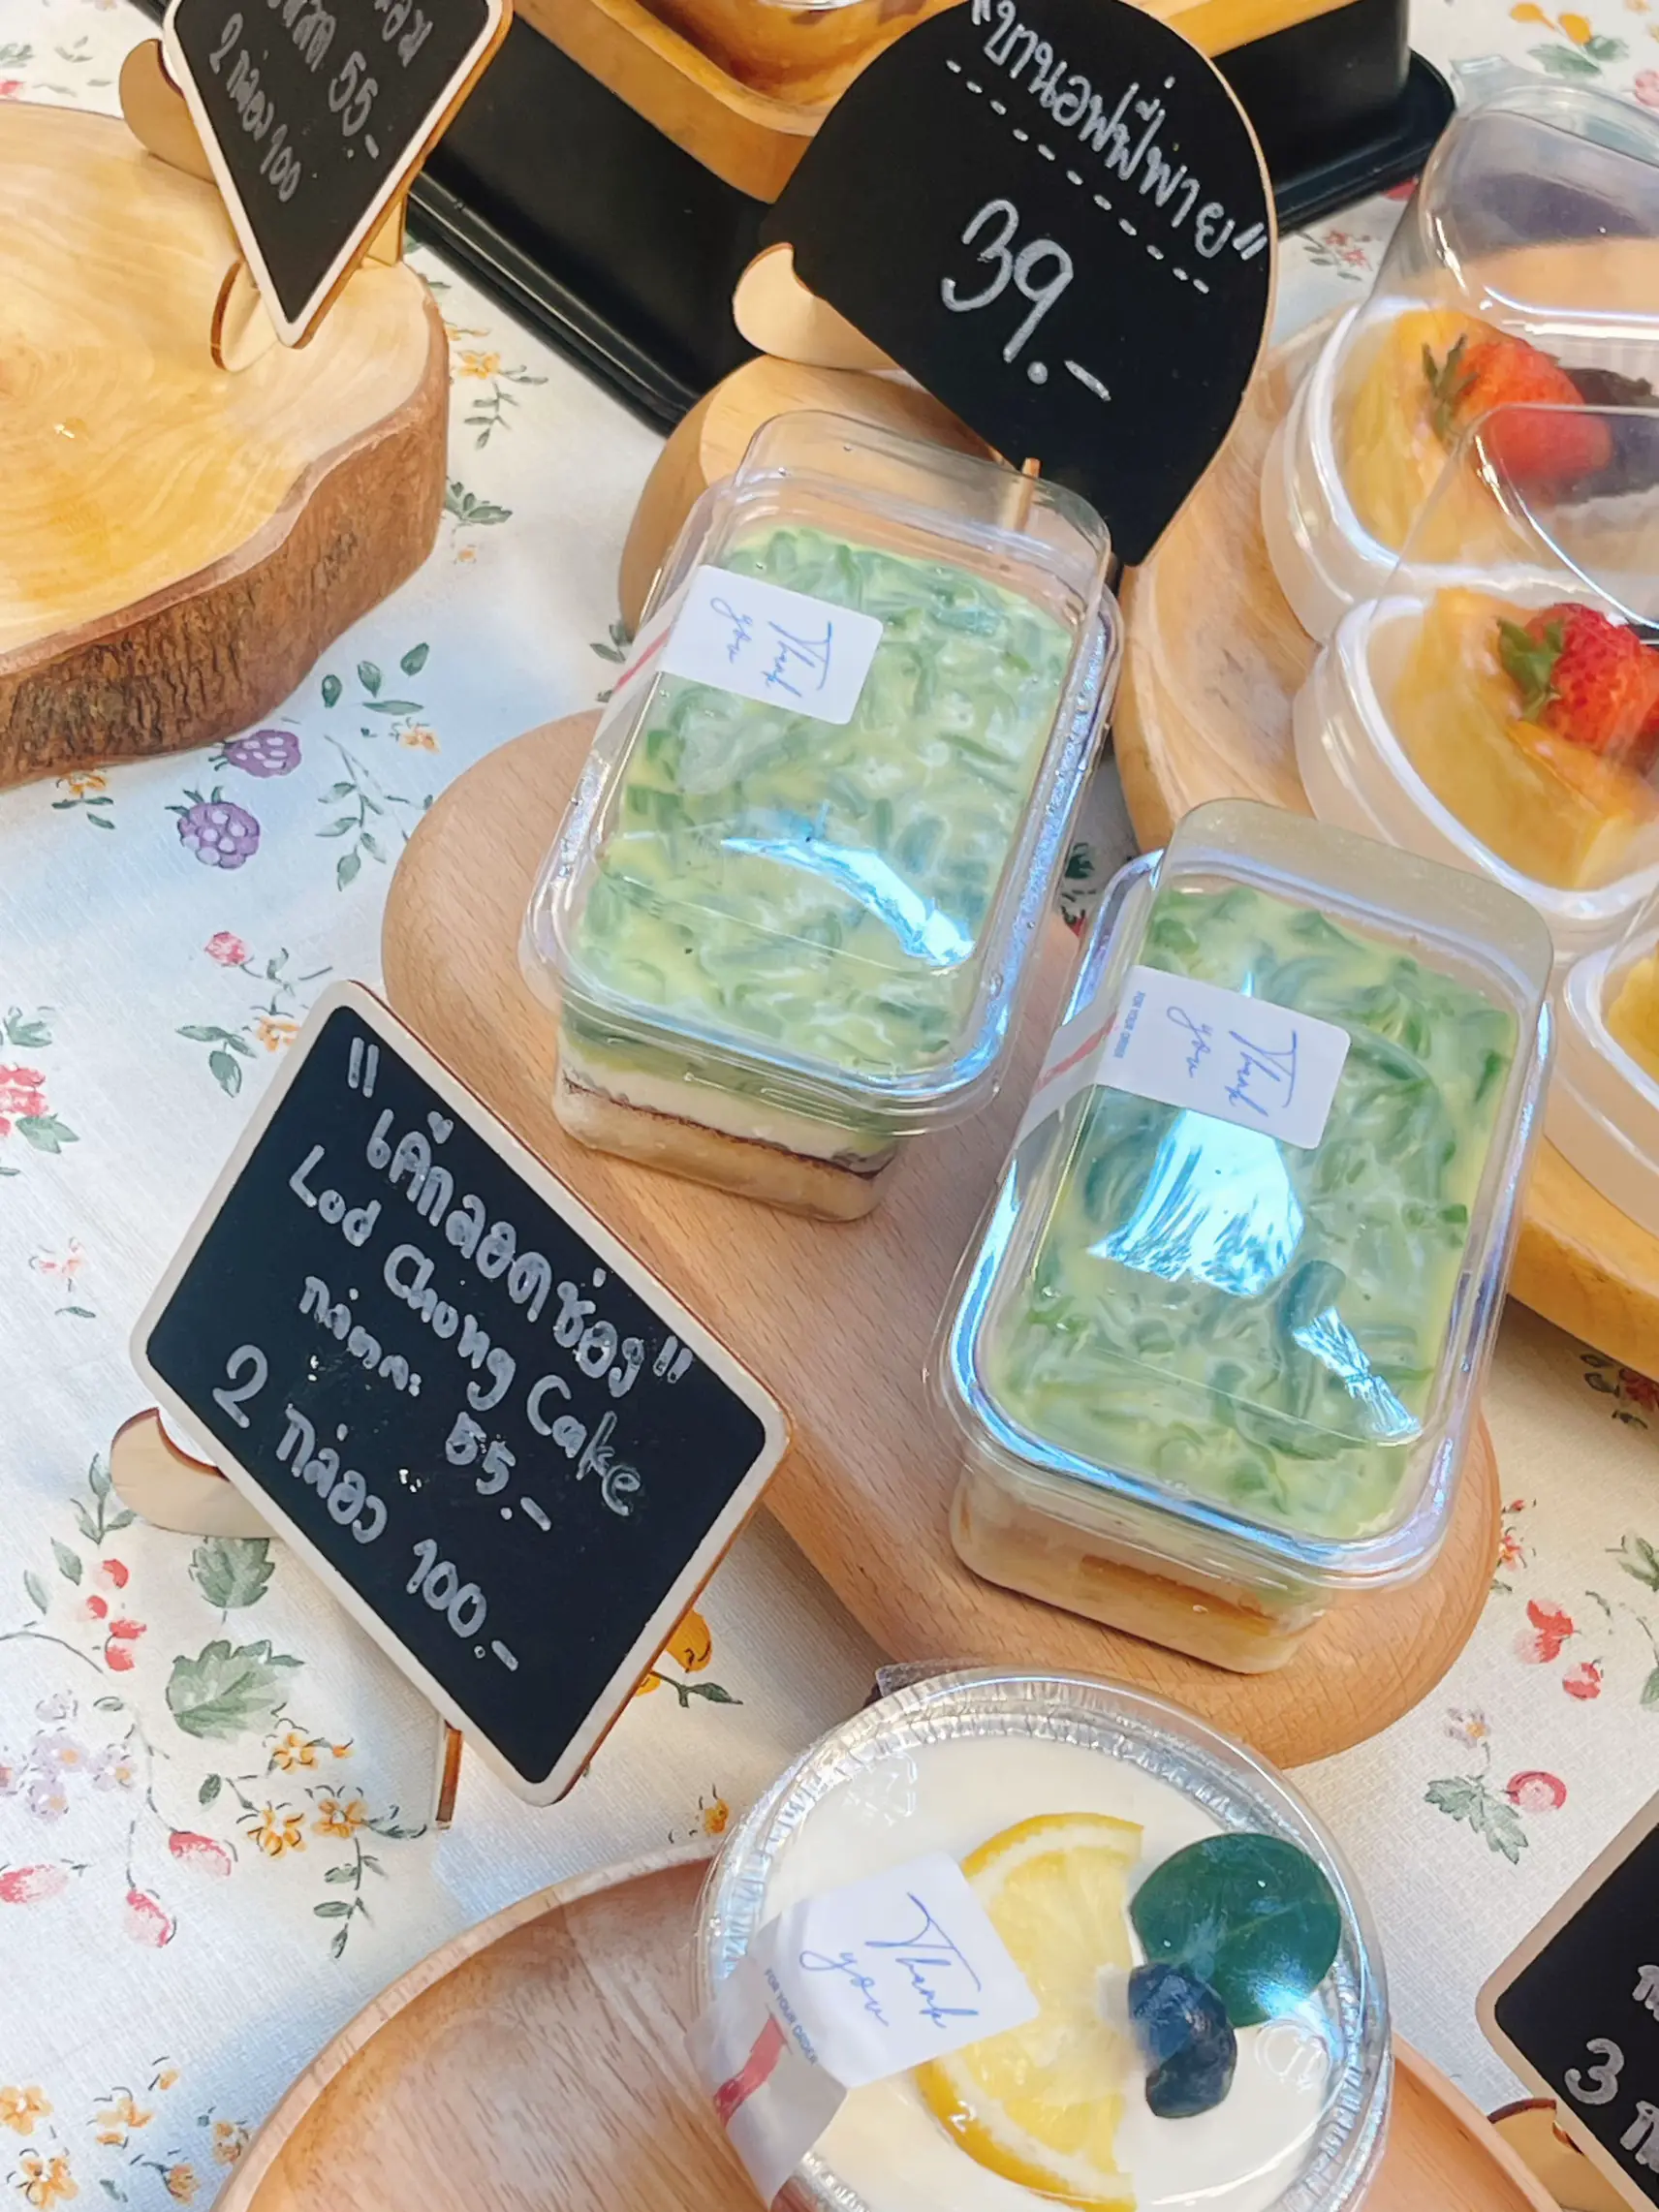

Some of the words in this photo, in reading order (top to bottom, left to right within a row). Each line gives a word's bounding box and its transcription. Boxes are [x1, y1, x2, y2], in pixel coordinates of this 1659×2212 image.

[210, 14, 242, 74] 2
[290, 1144, 382, 1247] Lod
[384, 1243, 516, 1412] Chong
[526, 1374, 642, 1516] Cake
[212, 1344, 268, 1429] 2
[1564, 2038, 1625, 2105] 3
